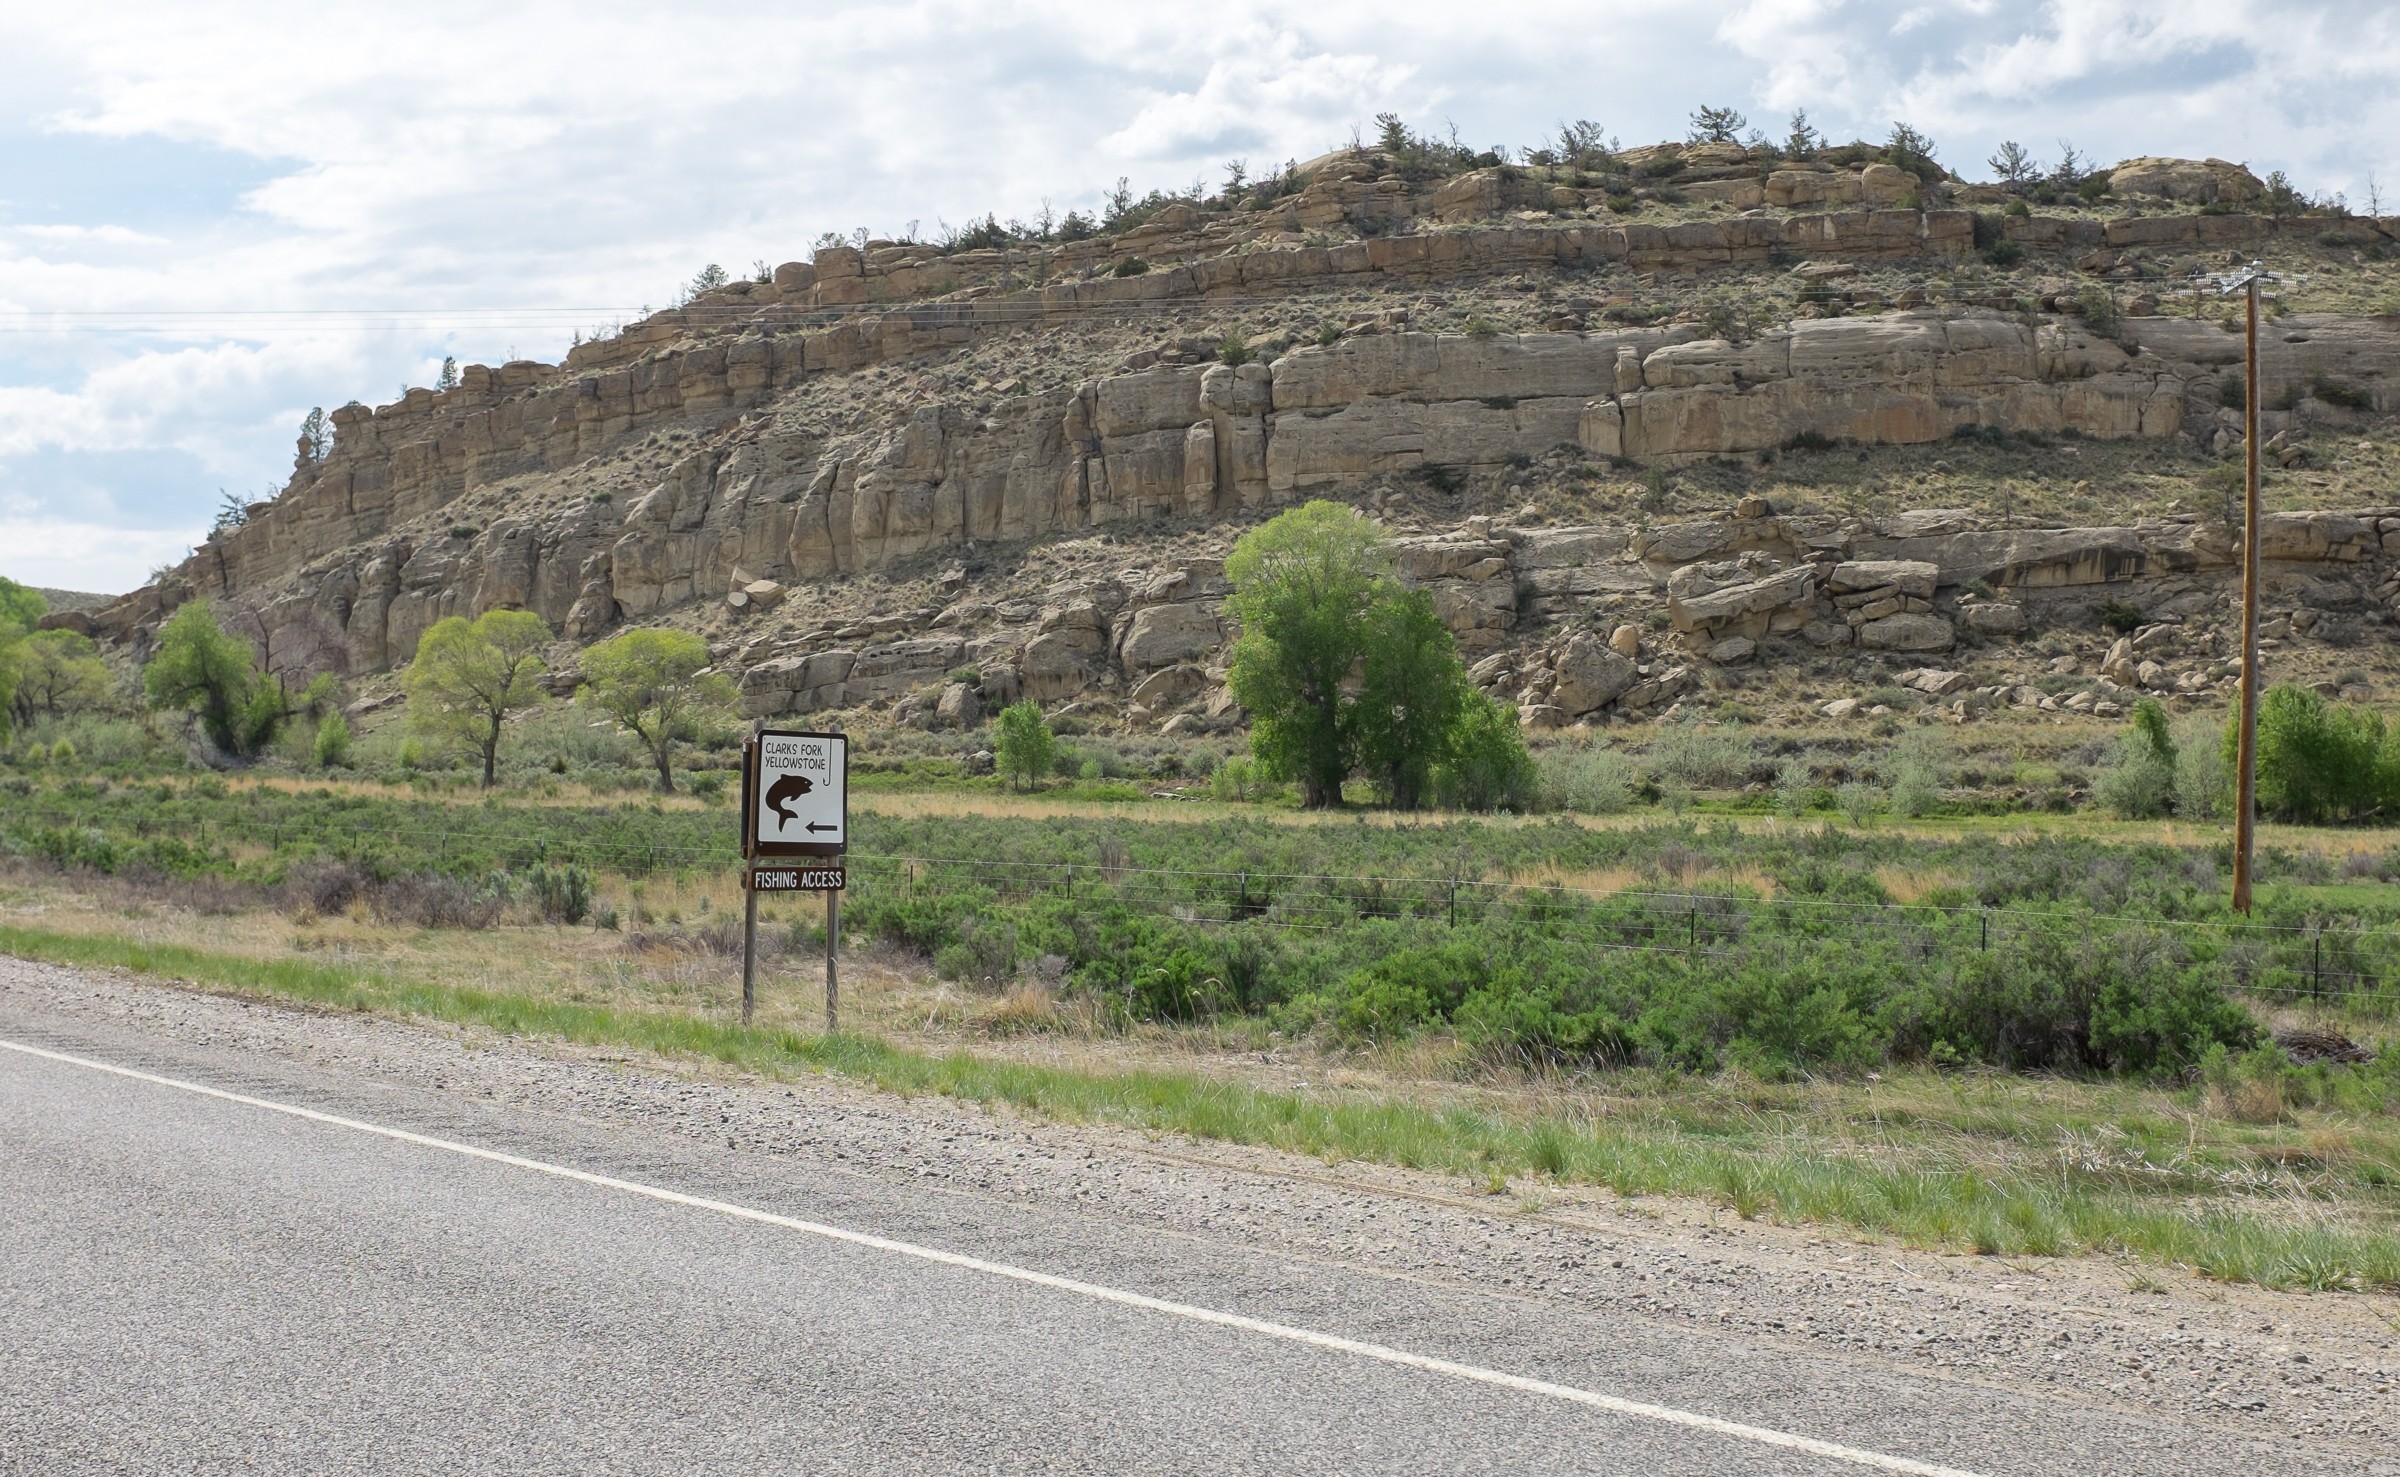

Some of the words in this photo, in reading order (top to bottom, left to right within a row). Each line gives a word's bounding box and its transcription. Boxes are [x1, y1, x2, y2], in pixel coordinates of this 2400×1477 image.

[765, 742, 798, 755] CLARKS
[801, 744, 823, 756] FORK
[765, 756, 826, 770] YELLOWSTONE
[755, 871, 798, 888] FISHING
[801, 871, 843, 888] ACCESS
